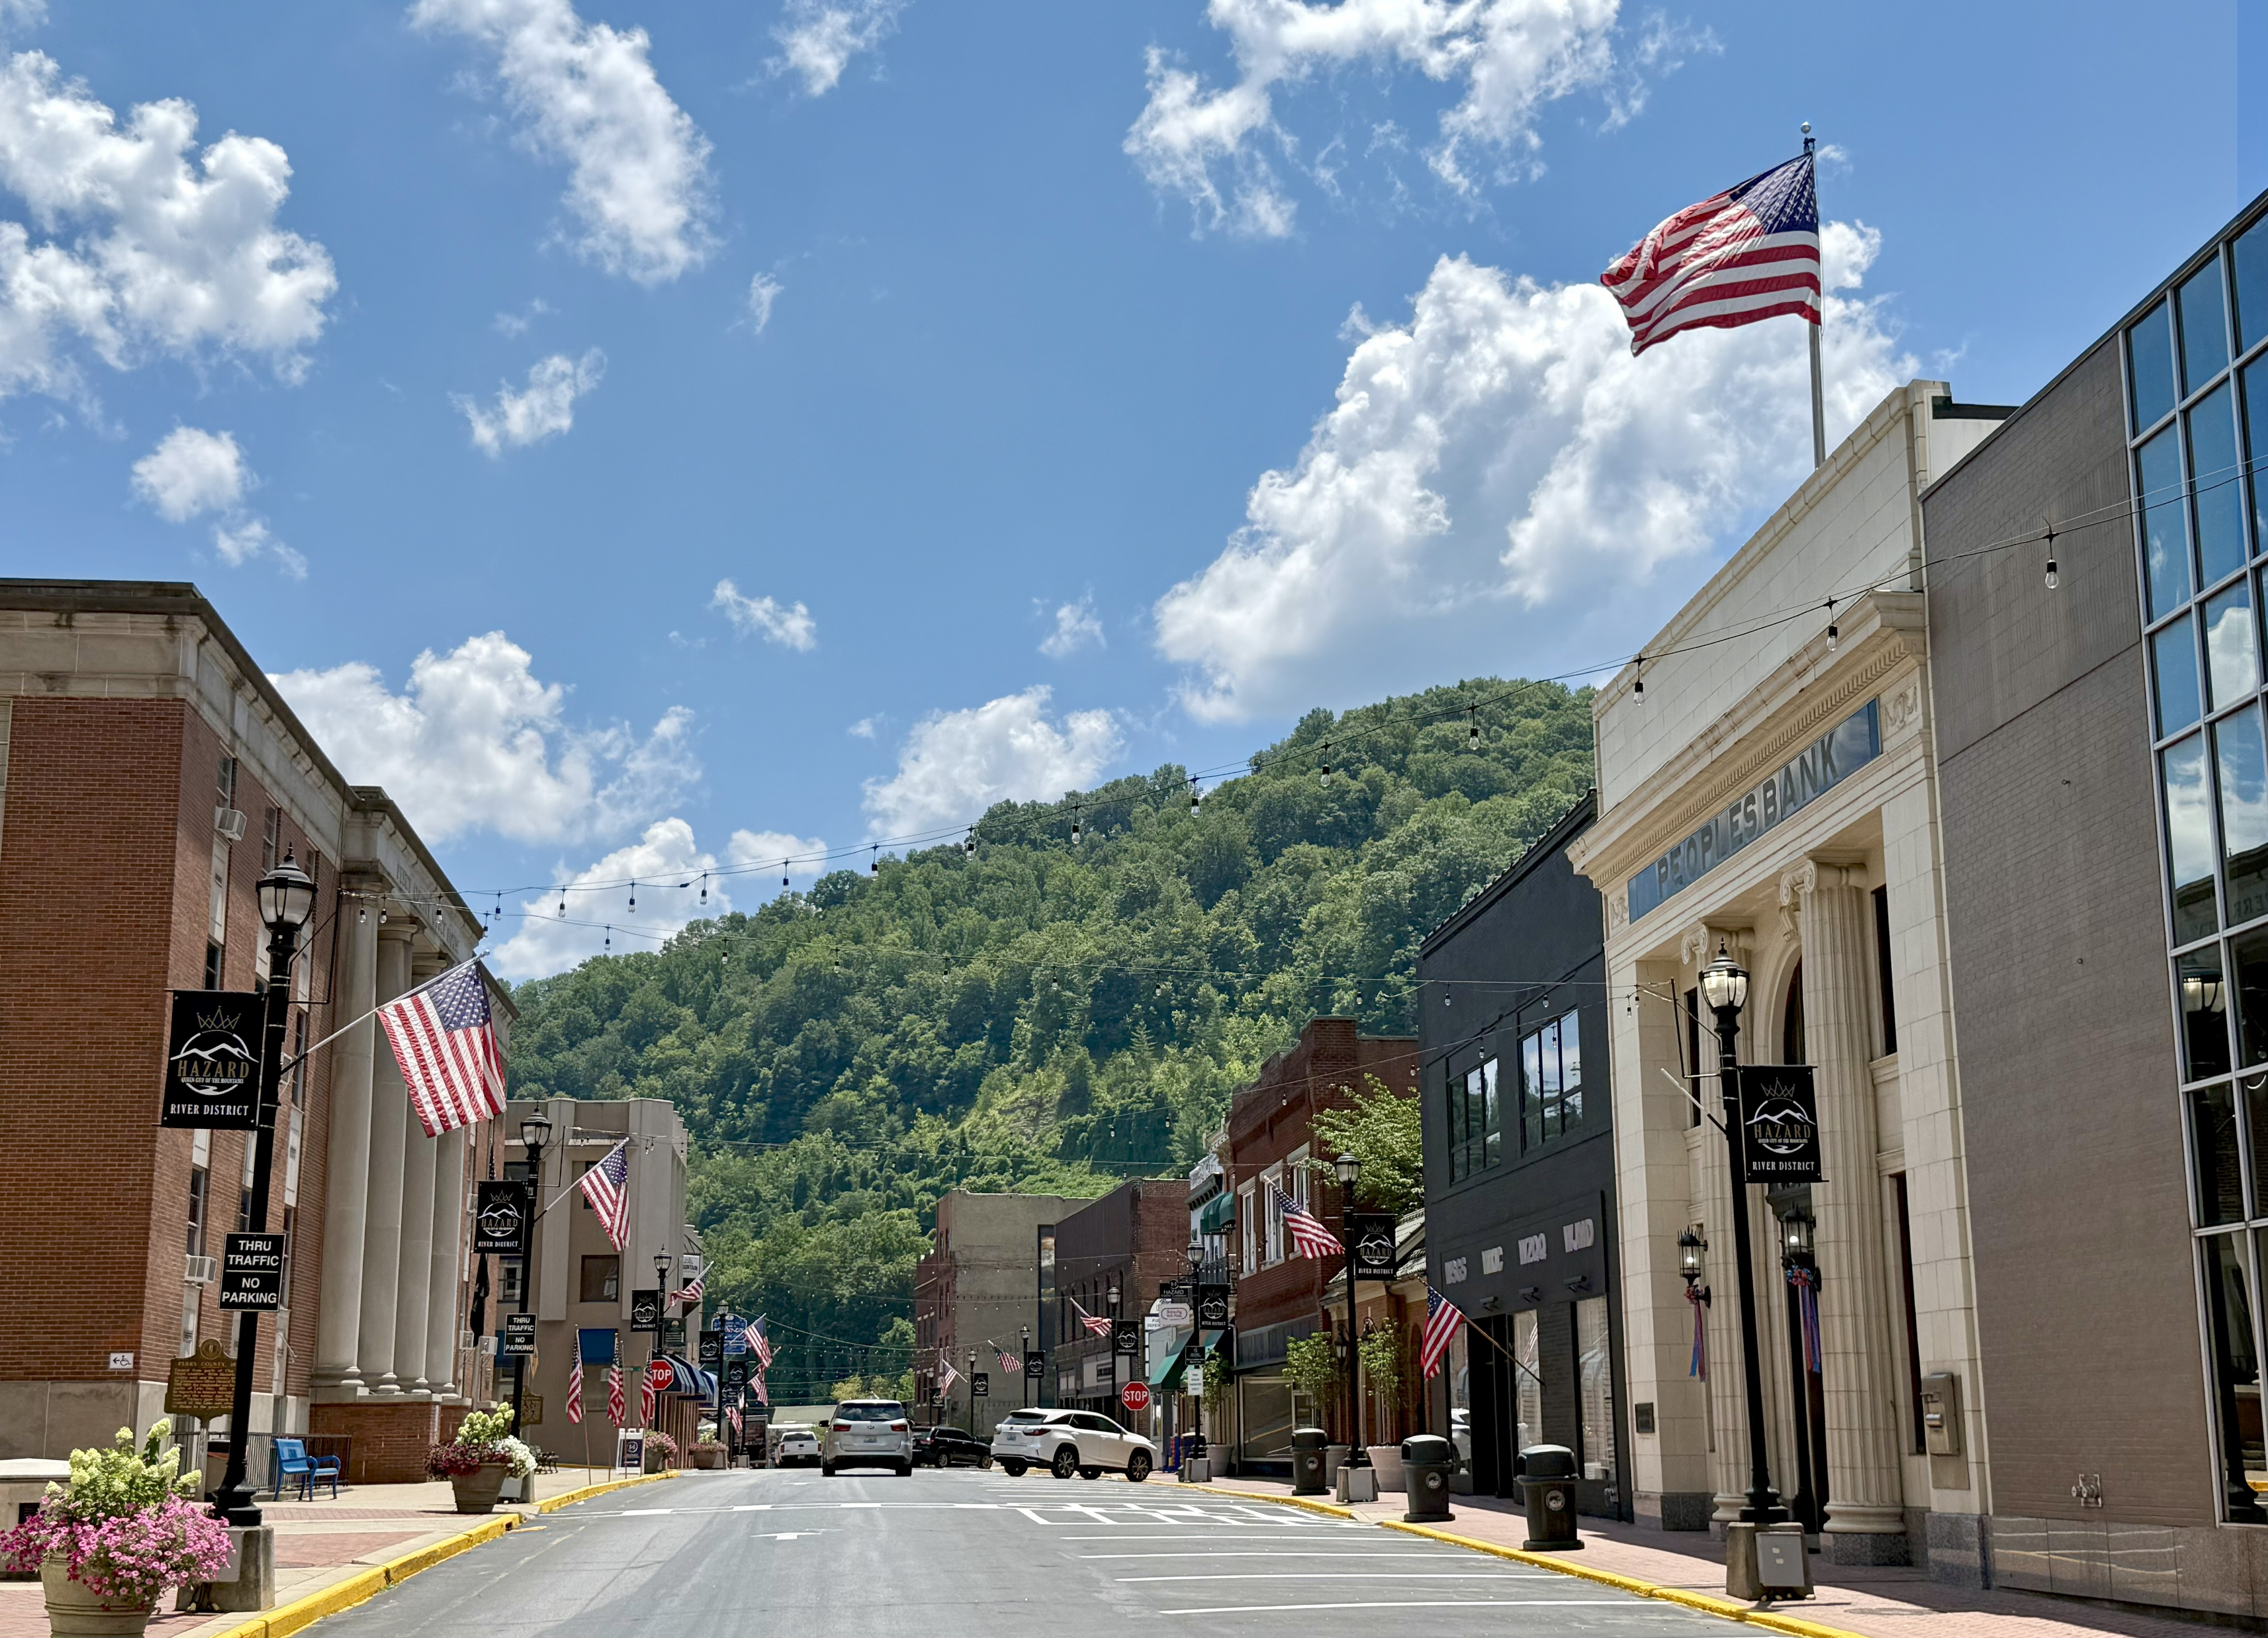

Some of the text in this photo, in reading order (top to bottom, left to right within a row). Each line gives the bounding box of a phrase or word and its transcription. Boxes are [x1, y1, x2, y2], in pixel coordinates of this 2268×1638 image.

[1657, 731, 1839, 899] PEOPLES BANK
[178, 1060, 249, 1078] HAZARD
[170, 1103, 249, 1116] RIVER DISTRICT
[1754, 1124, 1811, 1139] HAZARD
[1752, 1161, 1815, 1171] RIVER DISTRICT
[481, 1218, 518, 1227] HAZARD
[238, 1240, 271, 1251] THRU
[1360, 1247, 1392, 1257] HAZARD
[228, 1254, 279, 1266] TRAFFIC
[242, 1277, 260, 1288] NO
[222, 1291, 277, 1304] PARKING
[651, 1370, 671, 1380] TOP
[1124, 1391, 1148, 1401] STOP
